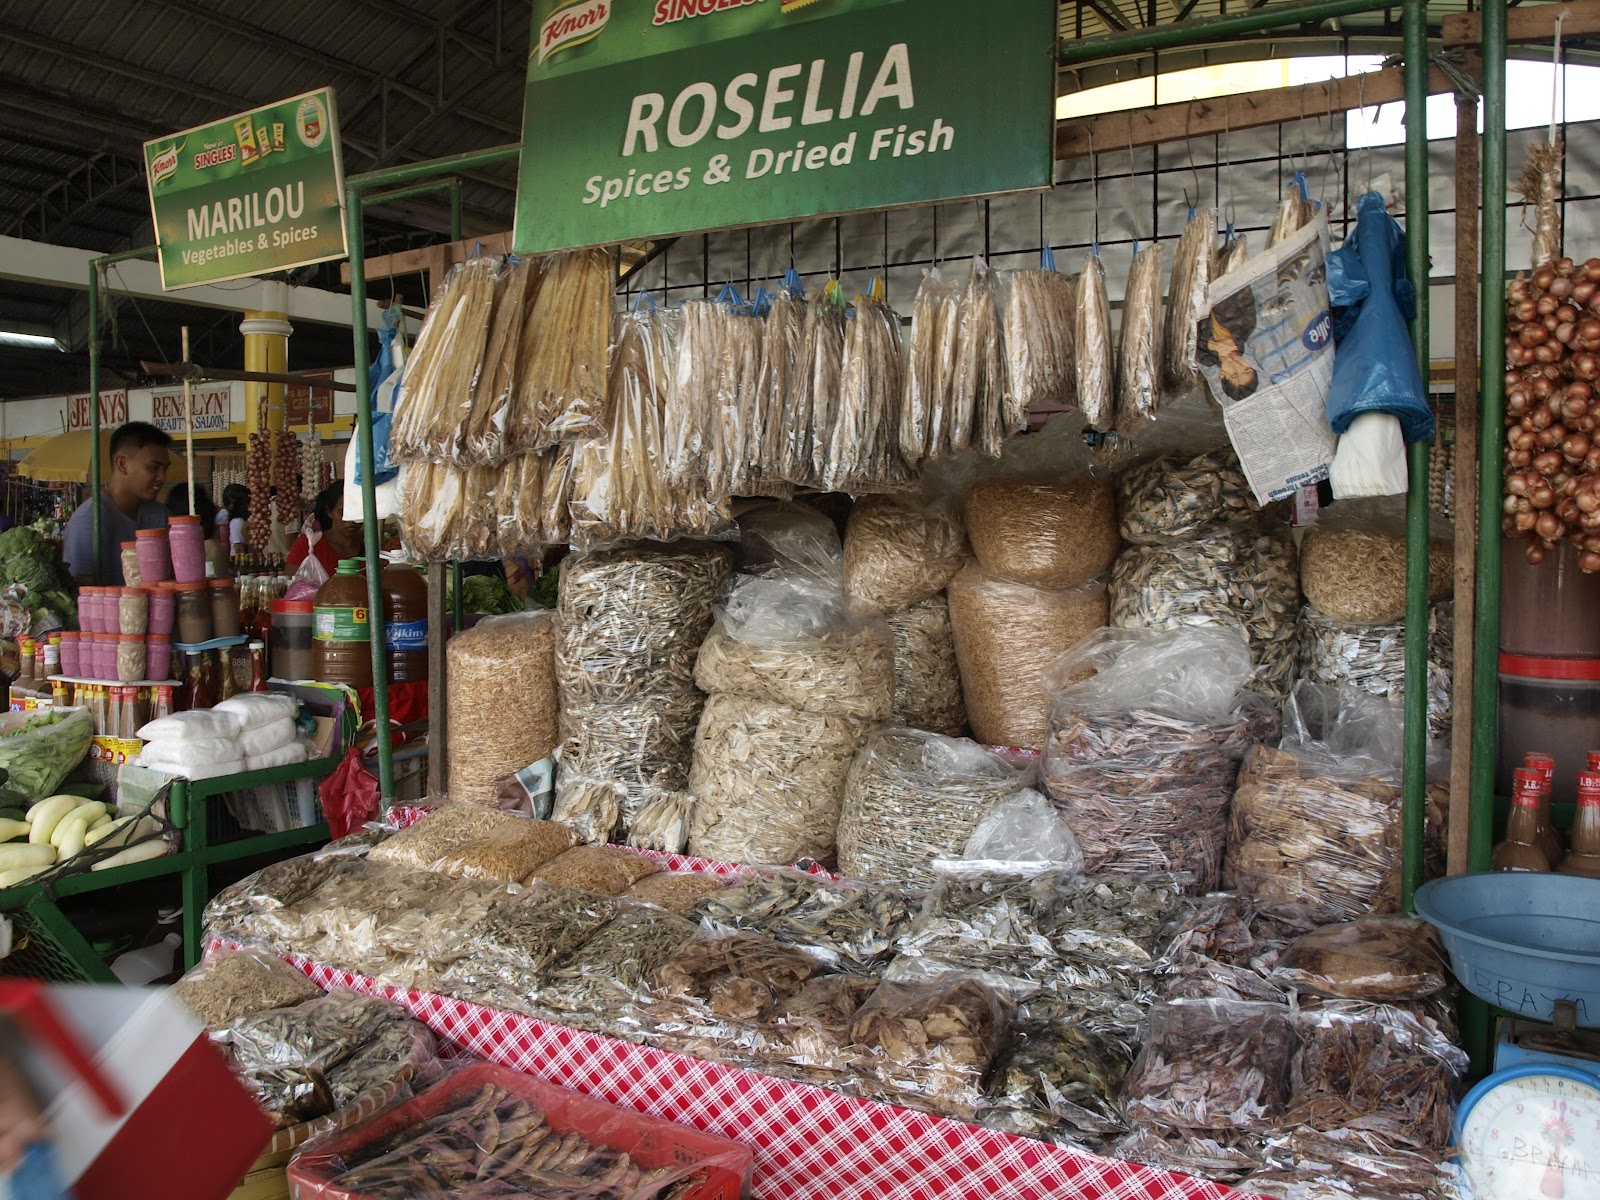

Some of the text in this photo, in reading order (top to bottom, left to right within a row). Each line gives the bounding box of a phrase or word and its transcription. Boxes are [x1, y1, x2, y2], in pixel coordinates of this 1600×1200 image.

[543, 0, 606, 48] Knorr
[621, 43, 916, 157] ROSELIA
[152, 155, 177, 177] Knorr
[195, 144, 236, 169] SINGLES!
[581, 118, 955, 208] Spices & Dried Fish
[187, 181, 304, 242] MARILOU
[182, 225, 318, 265] Vegetables & Spices
[356, 609, 365, 620] 6
[1516, 1103, 1525, 1115] 9
